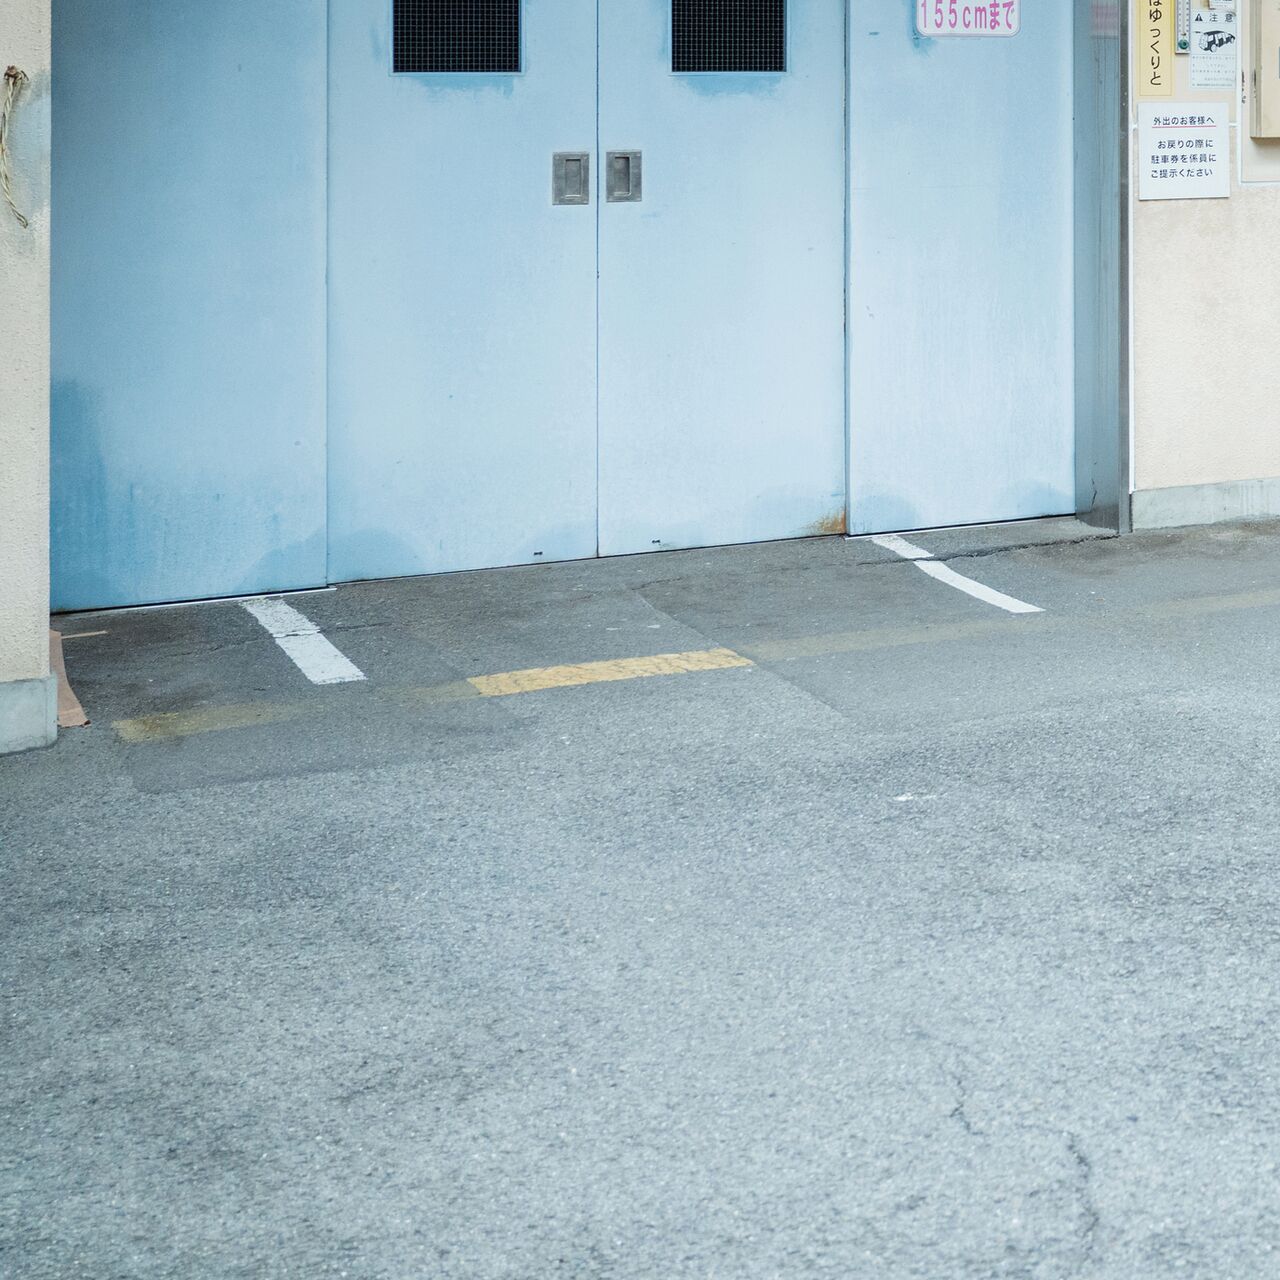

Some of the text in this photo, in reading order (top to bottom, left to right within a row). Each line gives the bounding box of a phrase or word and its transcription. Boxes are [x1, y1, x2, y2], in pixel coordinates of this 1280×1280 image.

[1209, 13, 1235, 23] 注意
[1153, 116, 1215, 126] 外出のお客様へ
[1157, 139, 1214, 149] お戻りの際に
[1150, 153, 1217, 165] 駐車券を係員に
[1150, 168, 1213, 179] ご提示ください
